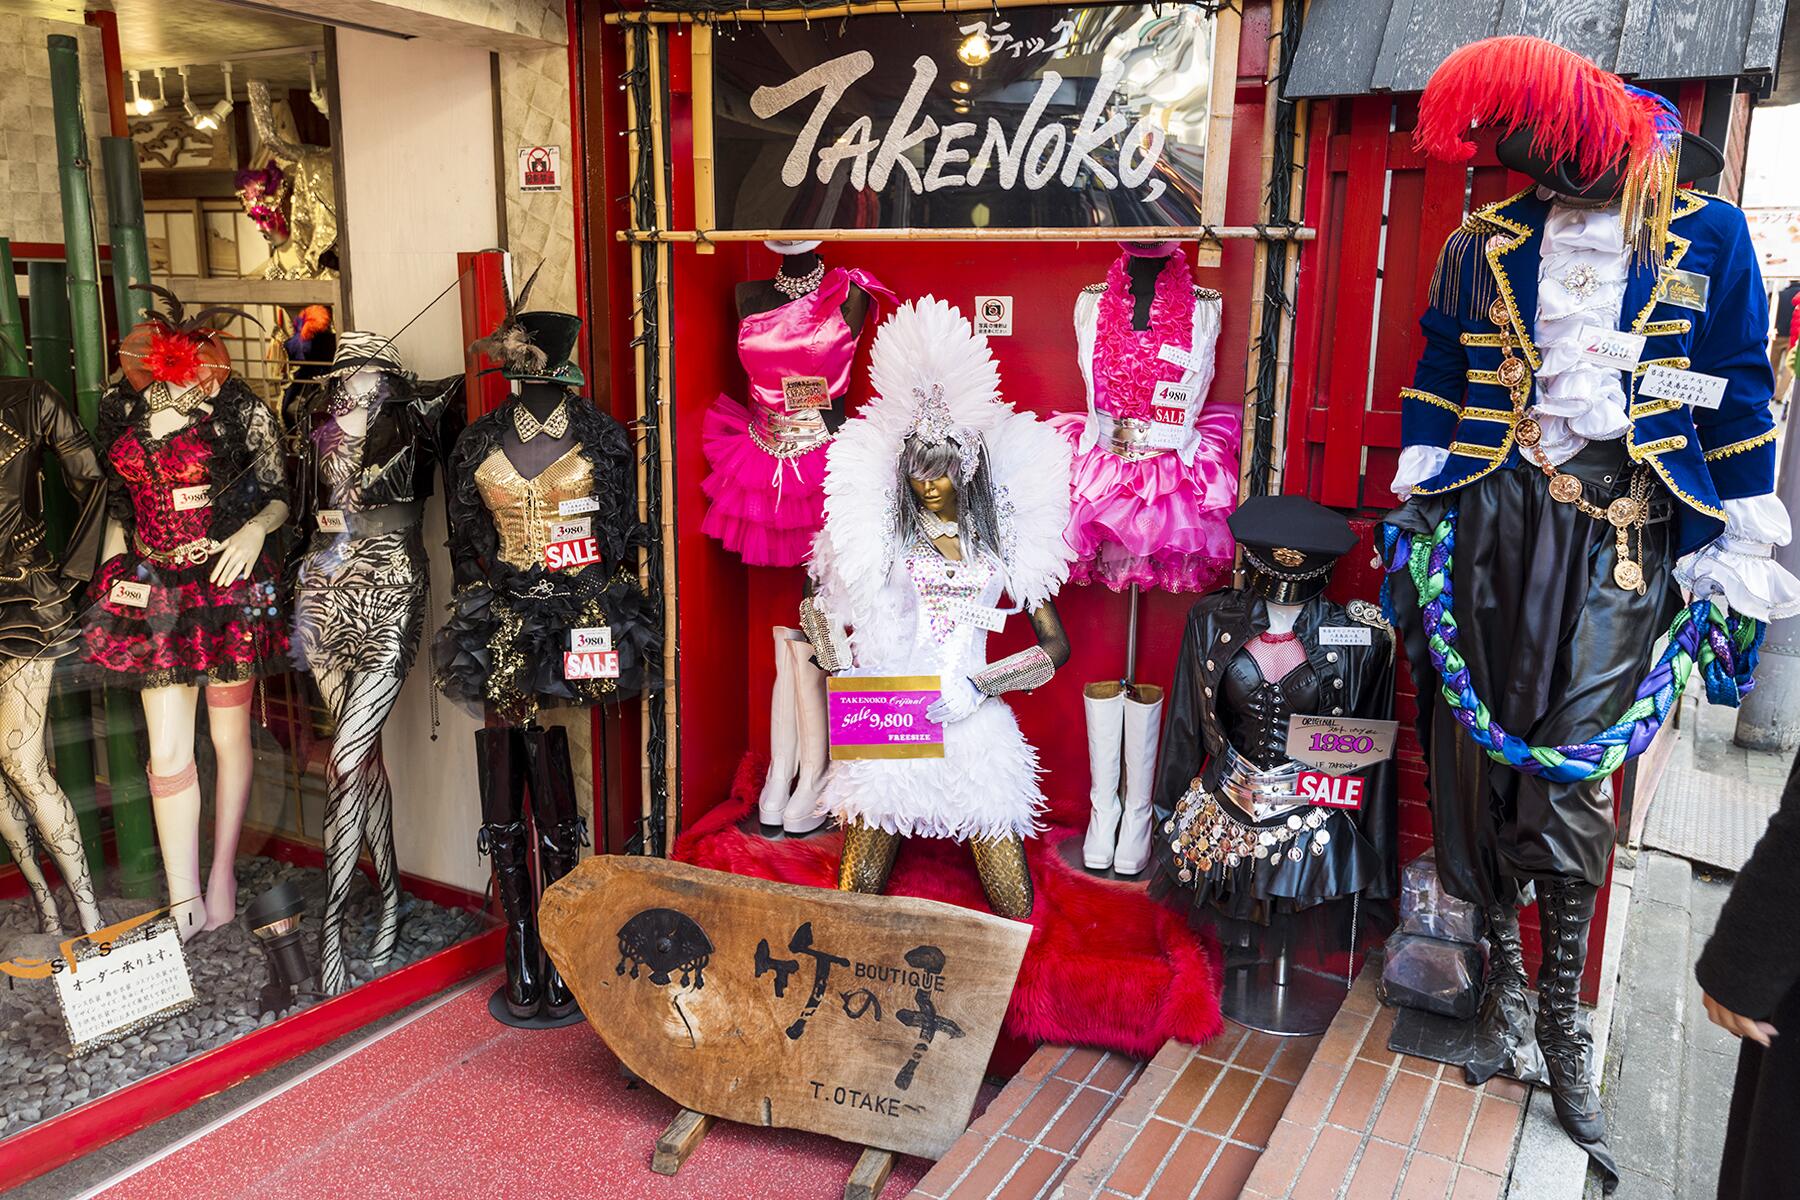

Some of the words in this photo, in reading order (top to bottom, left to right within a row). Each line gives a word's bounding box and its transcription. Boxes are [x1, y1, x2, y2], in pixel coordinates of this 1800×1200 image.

[1159, 387, 1187, 401] 4980
[1155, 408, 1186, 425] SALE
[556, 525, 584, 537] 3980
[546, 538, 599, 569] SALE
[116, 586, 142, 600] 3980
[577, 634, 604, 647] 3980
[566, 653, 618, 677] SALE
[869, 713, 913, 730] 9,800
[1302, 717, 1337, 727] ORIGINAL
[1301, 775, 1361, 806] SALE
[855, 962, 947, 993] BOUTIQUE
